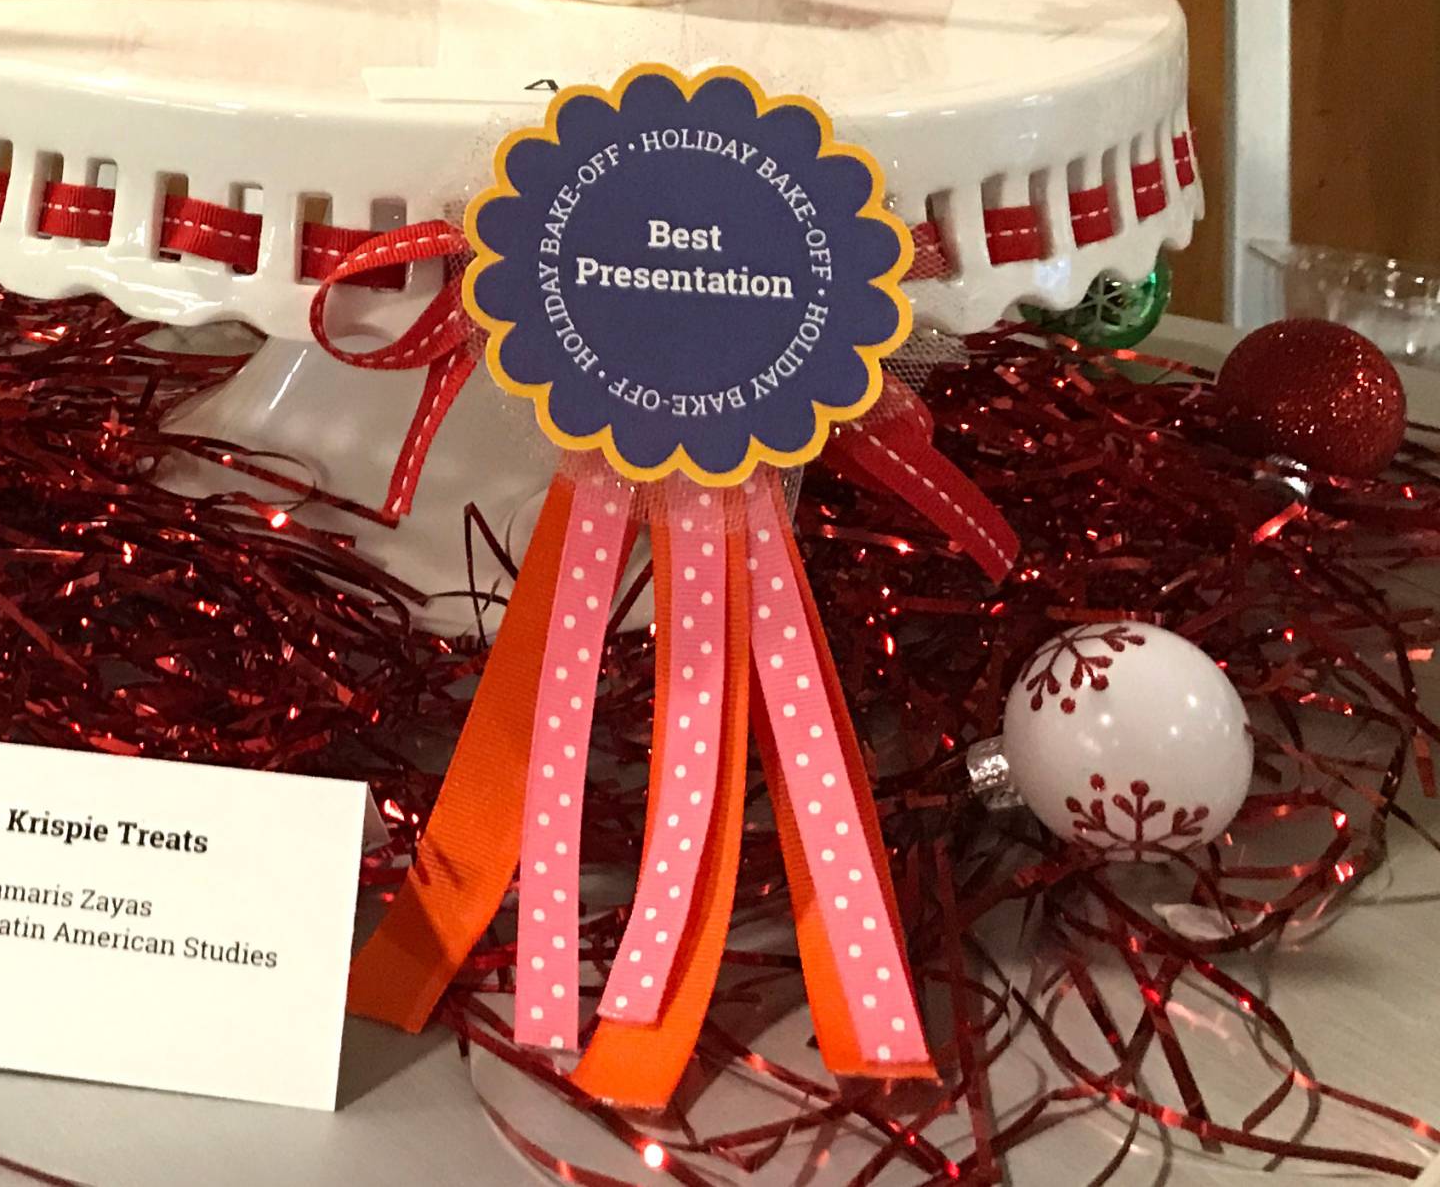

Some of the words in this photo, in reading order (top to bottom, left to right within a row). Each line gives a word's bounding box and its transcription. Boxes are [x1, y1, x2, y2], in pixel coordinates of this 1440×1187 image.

[540, 143, 621, 256] BAKE-OFF
[640, 128, 760, 165] HOLIDAY
[756, 155, 832, 281] BAKE-OFF
[647, 220, 722, 252] Best
[576, 258, 794, 299] Presentation
[538, 260, 599, 372] HOLIDAY
[751, 300, 829, 402] HOLIDAY
[608, 379, 745, 416] BAKE-OFF
[6, 808, 109, 846] Krispie
[117, 821, 208, 854] Treats
[80, 889, 152, 919] Zayas
[52, 921, 176, 957] American
[183, 938, 279, 969] Studies
